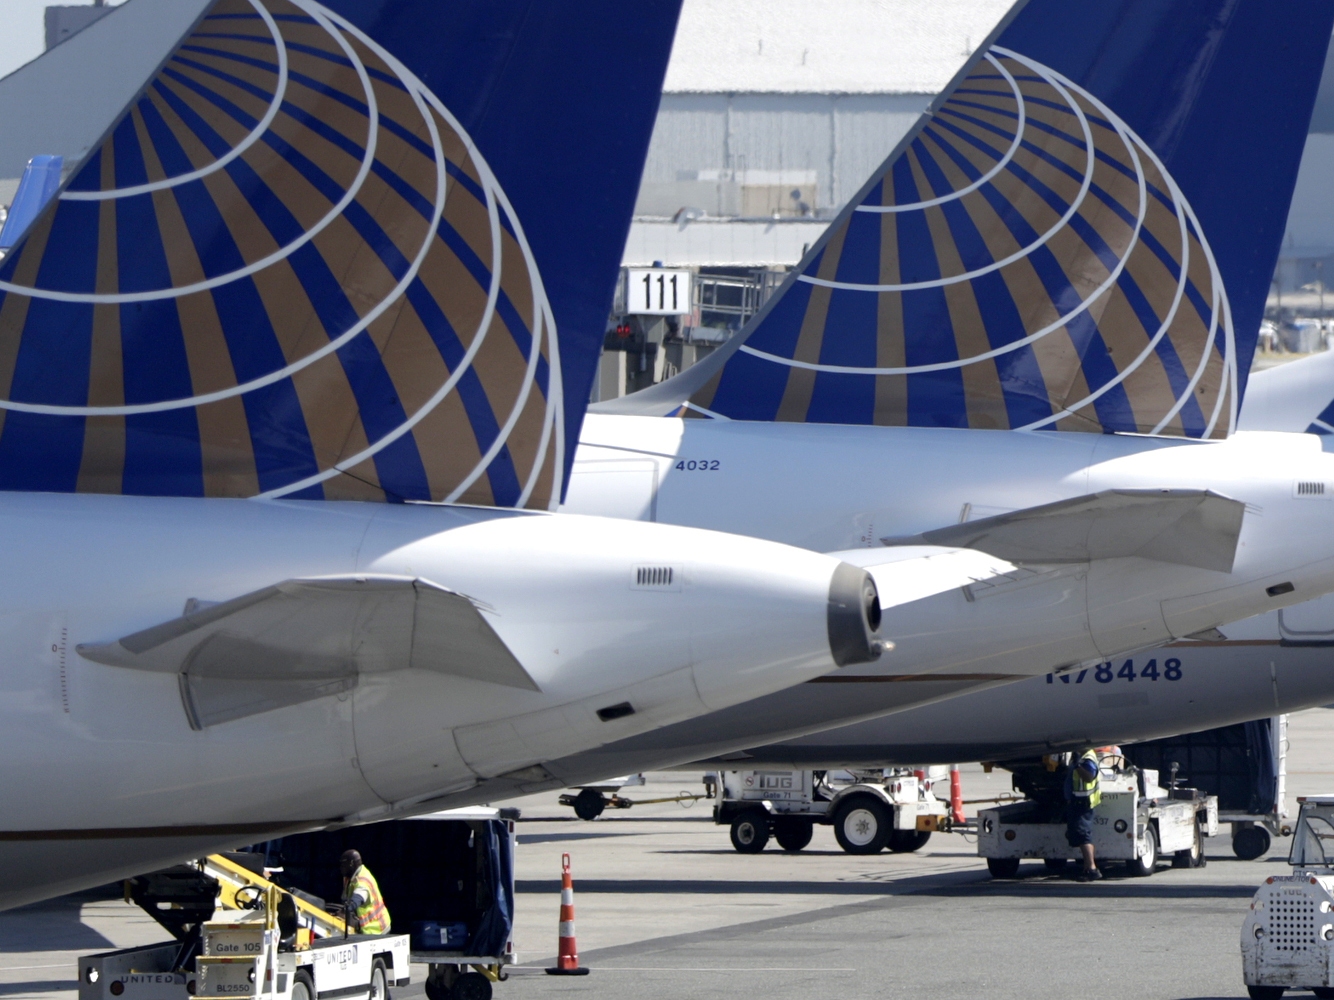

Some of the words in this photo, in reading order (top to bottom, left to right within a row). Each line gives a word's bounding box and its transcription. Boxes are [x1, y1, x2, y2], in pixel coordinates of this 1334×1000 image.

[642, 273, 677, 310] 111
[675, 459, 720, 471] 4032
[754, 770, 793, 788] TUG
[763, 791, 780, 799] Gate
[783, 791, 791, 799] 71
[217, 943, 239, 952] Gate
[244, 943, 261, 951] 105
[327, 949, 352, 965] UNITED
[121, 975, 174, 984] UNITED
[217, 984, 250, 993] BL2550
